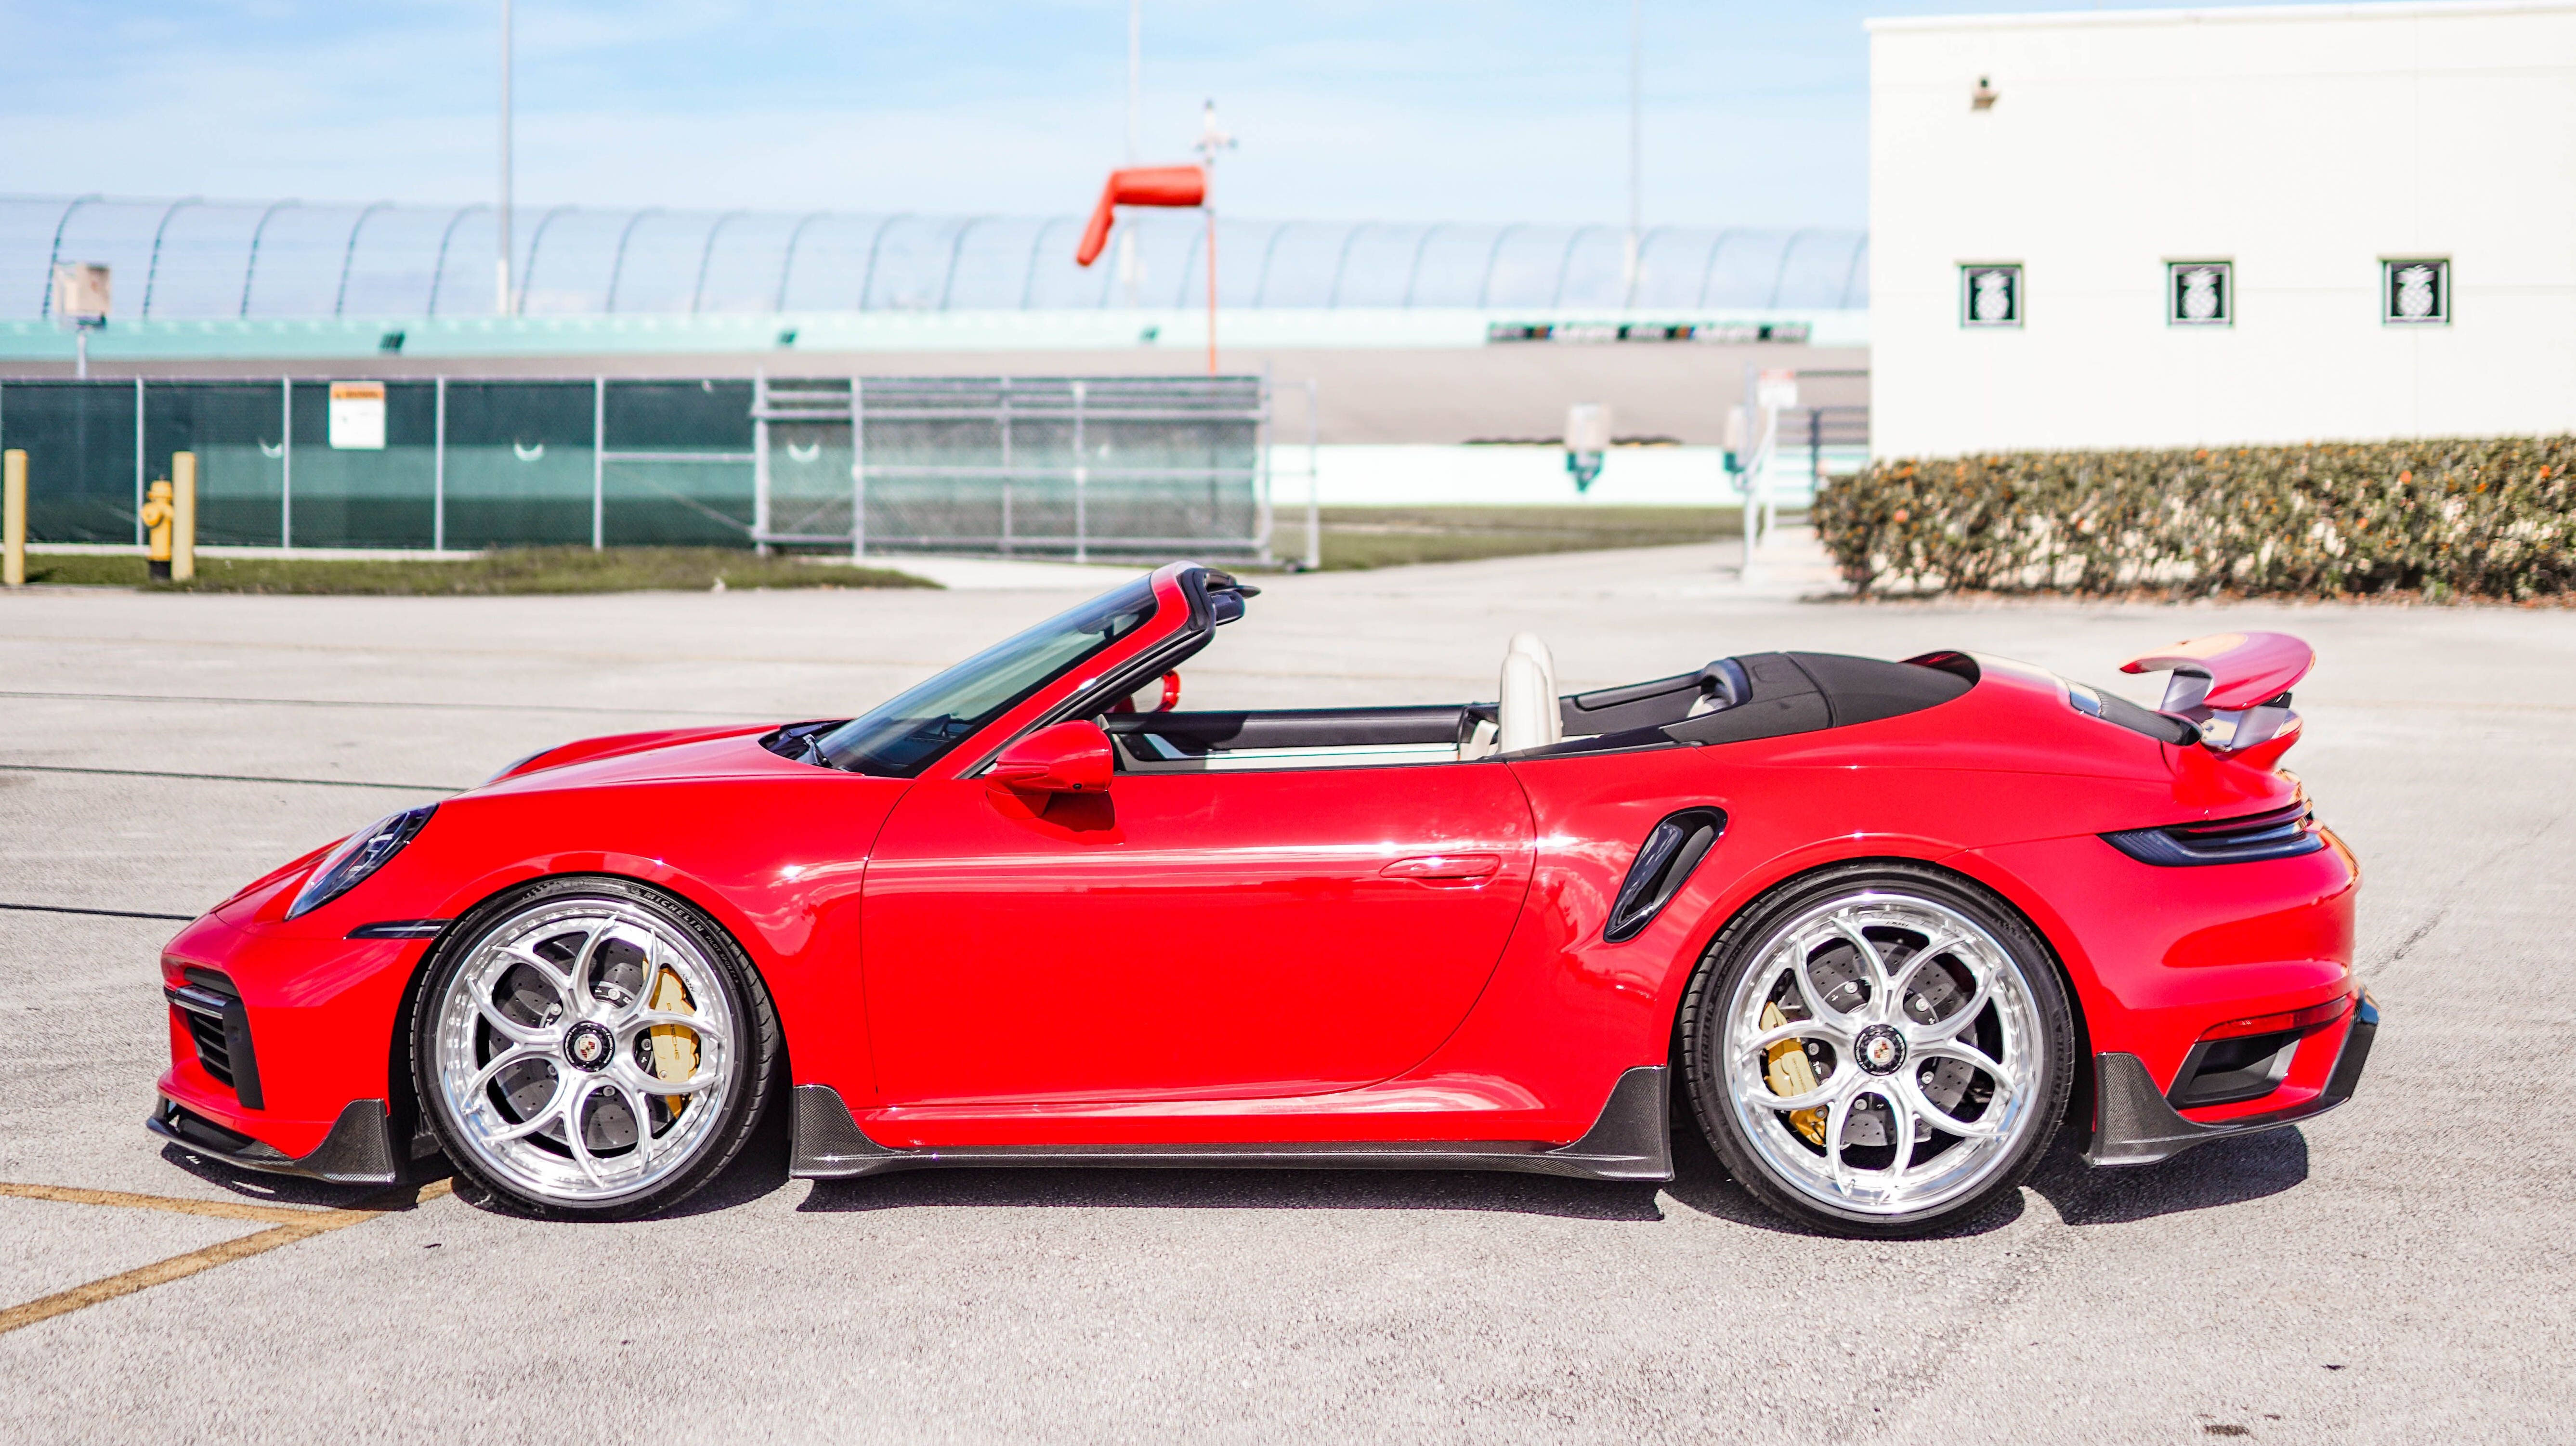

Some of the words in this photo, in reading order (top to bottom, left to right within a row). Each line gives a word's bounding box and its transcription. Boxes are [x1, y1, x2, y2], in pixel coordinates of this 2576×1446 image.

[643, 892, 705, 932] MICHELIN
[705, 936, 721, 951] PILOT
[666, 1003, 680, 1060] PSCHE
